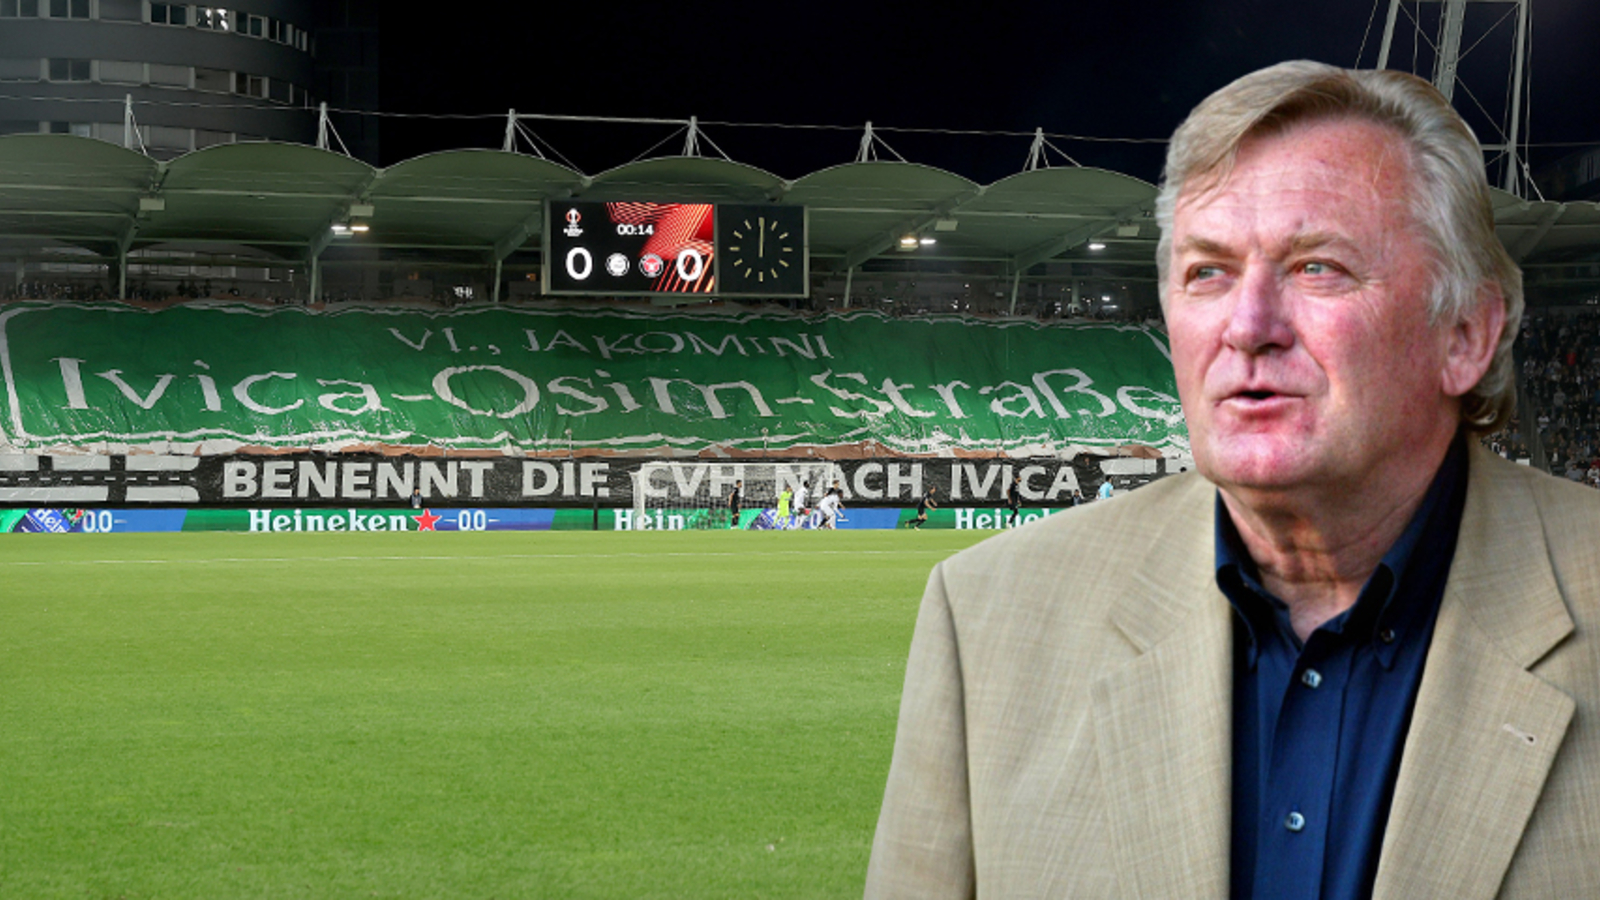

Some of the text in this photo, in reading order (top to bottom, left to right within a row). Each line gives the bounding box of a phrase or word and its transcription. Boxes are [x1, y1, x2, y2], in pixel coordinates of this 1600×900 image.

[617, 223, 654, 236] 00:14
[566, 247, 592, 280] 0
[676, 248, 704, 282] 0
[387, 326, 835, 361] VI., JAKOMINI
[49, 357, 1185, 426] Ivica-Osim-Straße
[222, 460, 1082, 500] BENENNT DIE CVH NACH IVICA
[247, 508, 409, 532] Heineken
[613, 508, 690, 531] Hein
